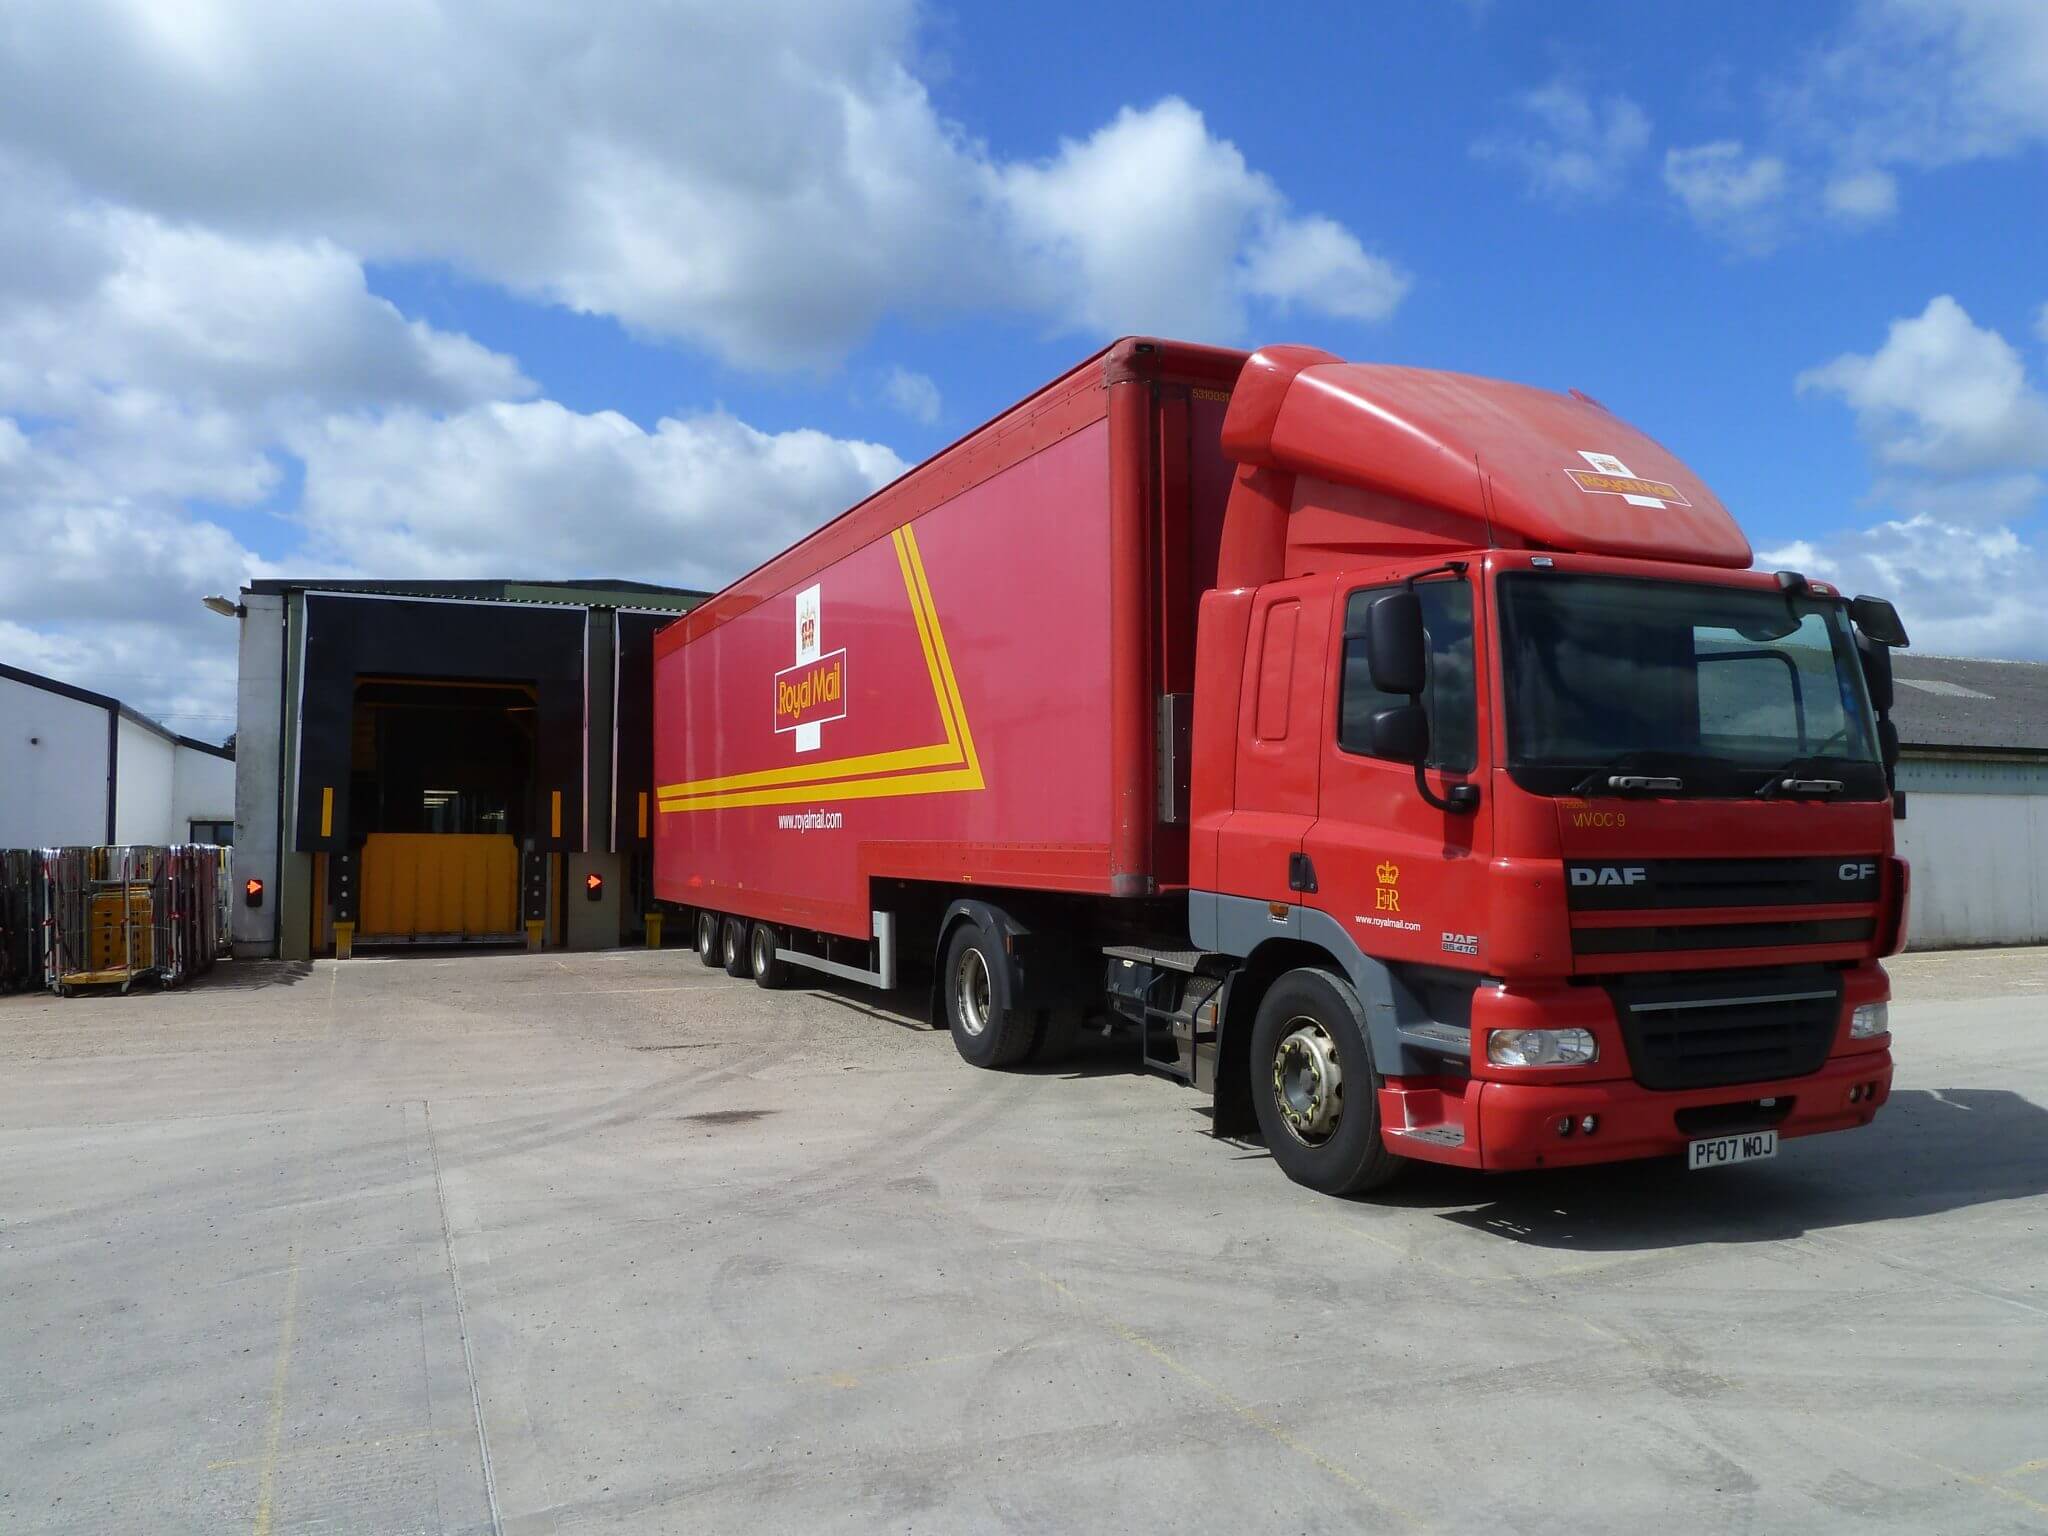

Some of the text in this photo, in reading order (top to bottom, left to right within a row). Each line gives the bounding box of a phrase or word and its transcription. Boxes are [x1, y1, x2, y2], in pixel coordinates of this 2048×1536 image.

[1577, 474, 1636, 493] Royal
[778, 661, 840, 718] Royal Mail
[778, 808, 842, 834] www.royalmail.com
[1617, 812, 1626, 827] 9
[1570, 863, 1876, 886] DAF CF
[1355, 914, 1421, 932] www.royalmail.com
[1441, 932, 1478, 944] DAF
[1695, 1133, 1773, 1165] PF07 WOJ
